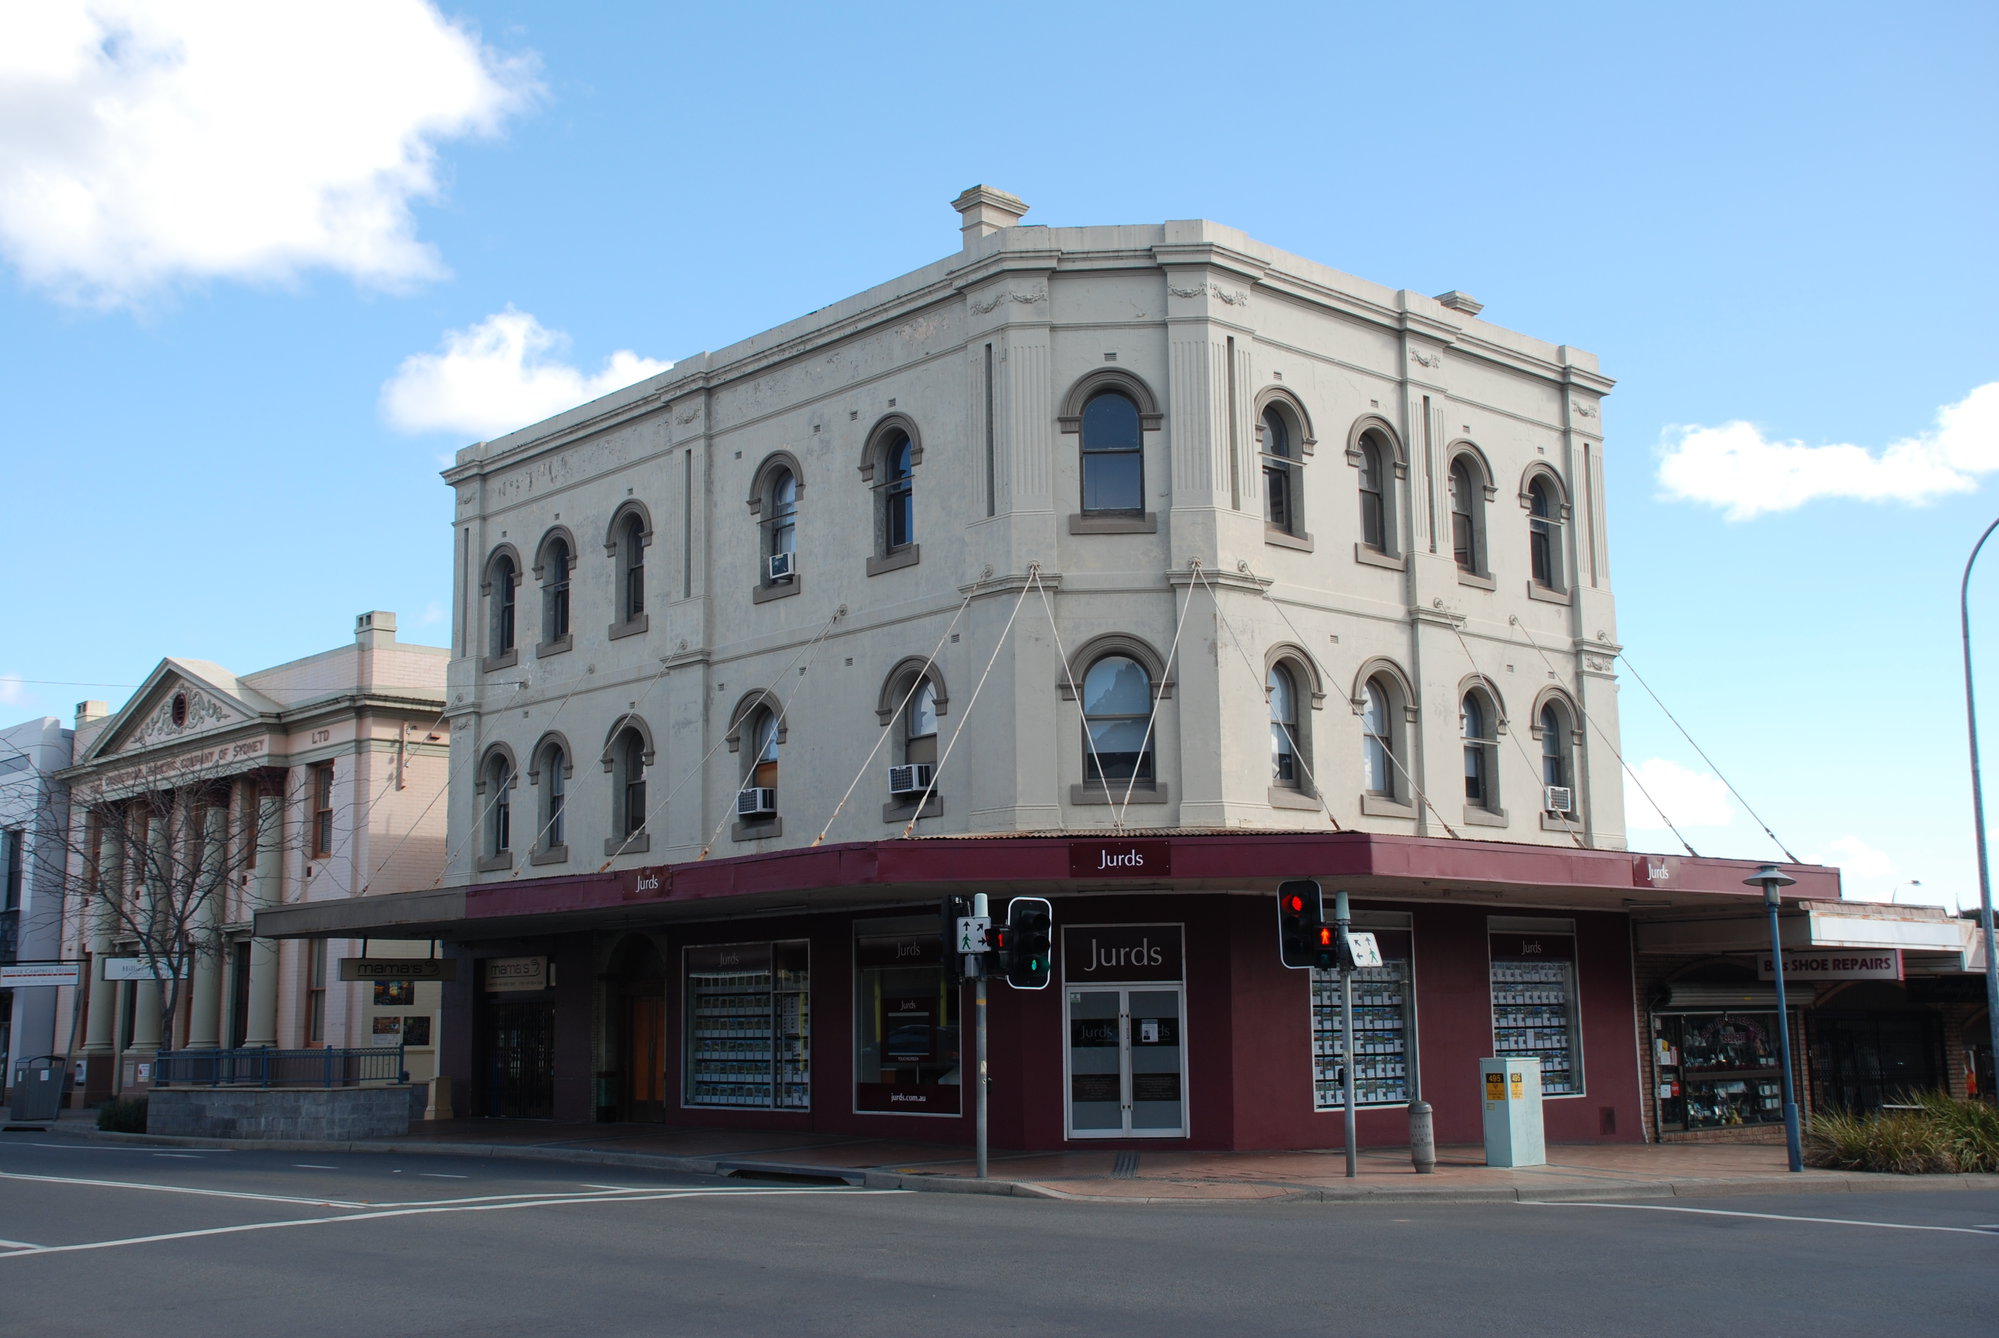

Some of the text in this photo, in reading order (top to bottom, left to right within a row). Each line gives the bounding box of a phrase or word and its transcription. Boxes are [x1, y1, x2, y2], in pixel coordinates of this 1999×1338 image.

[312, 730, 330, 745] LTD
[233, 739, 265, 757] SYDNEY
[1097, 849, 1144, 870] Jurds
[1647, 863, 1669, 881] Jurds
[635, 874, 659, 893] Jurds
[896, 940, 921, 959] Jurds
[1083, 937, 1163, 972] Jurds
[1521, 938, 1542, 956] Jurds
[718, 951, 740, 967] Jurds
[1791, 958, 1828, 972] SHOE
[1833, 957, 1891, 971] REPAIRS
[358, 964, 422, 974] mama's
[900, 999, 916, 1011] Jurds
[1080, 1023, 1113, 1040] Jurds
[1488, 1074, 1501, 1082] 495
[890, 1092, 927, 1103] jurds.com.au
